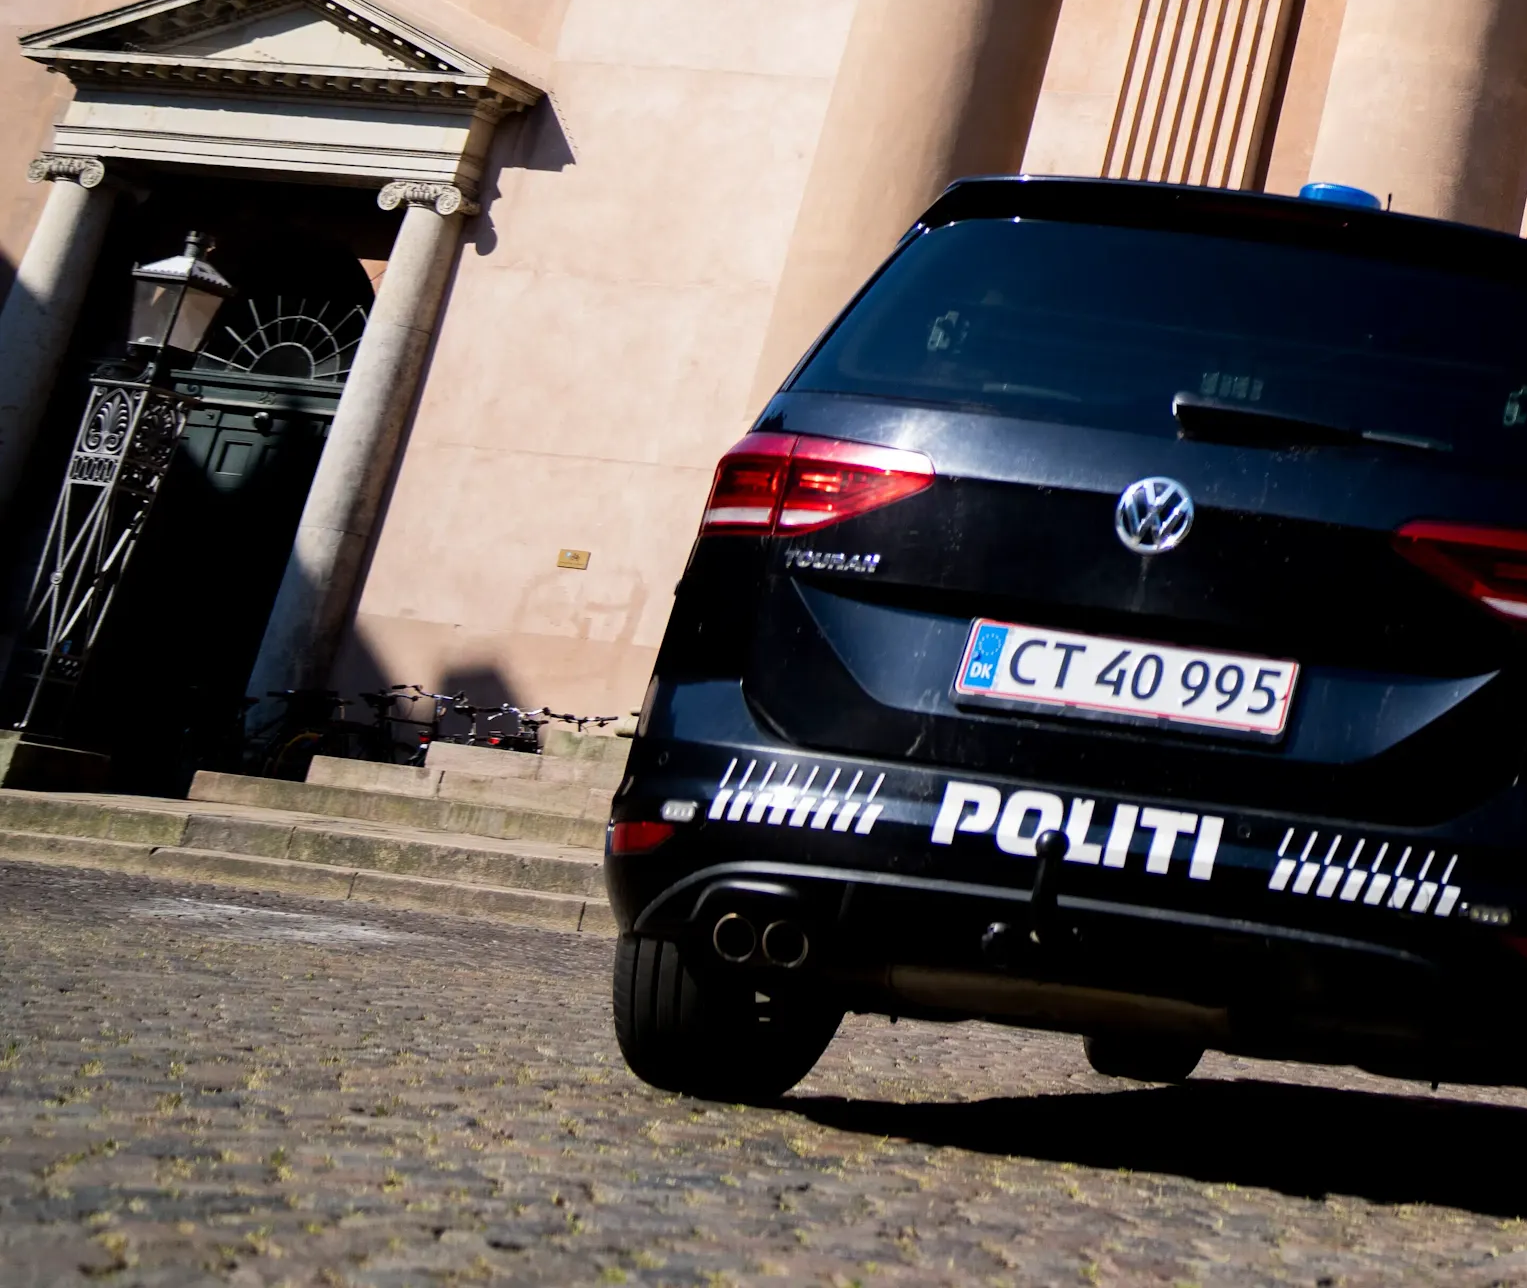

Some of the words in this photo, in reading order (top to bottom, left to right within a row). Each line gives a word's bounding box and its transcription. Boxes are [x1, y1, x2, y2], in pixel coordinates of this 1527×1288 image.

[784, 550, 881, 573] TOURAN
[969, 661, 992, 680] DK
[1008, 639, 1087, 689] CT
[1095, 649, 1165, 700] 40
[1180, 659, 1282, 715] 995
[930, 780, 1225, 881] POLITI
